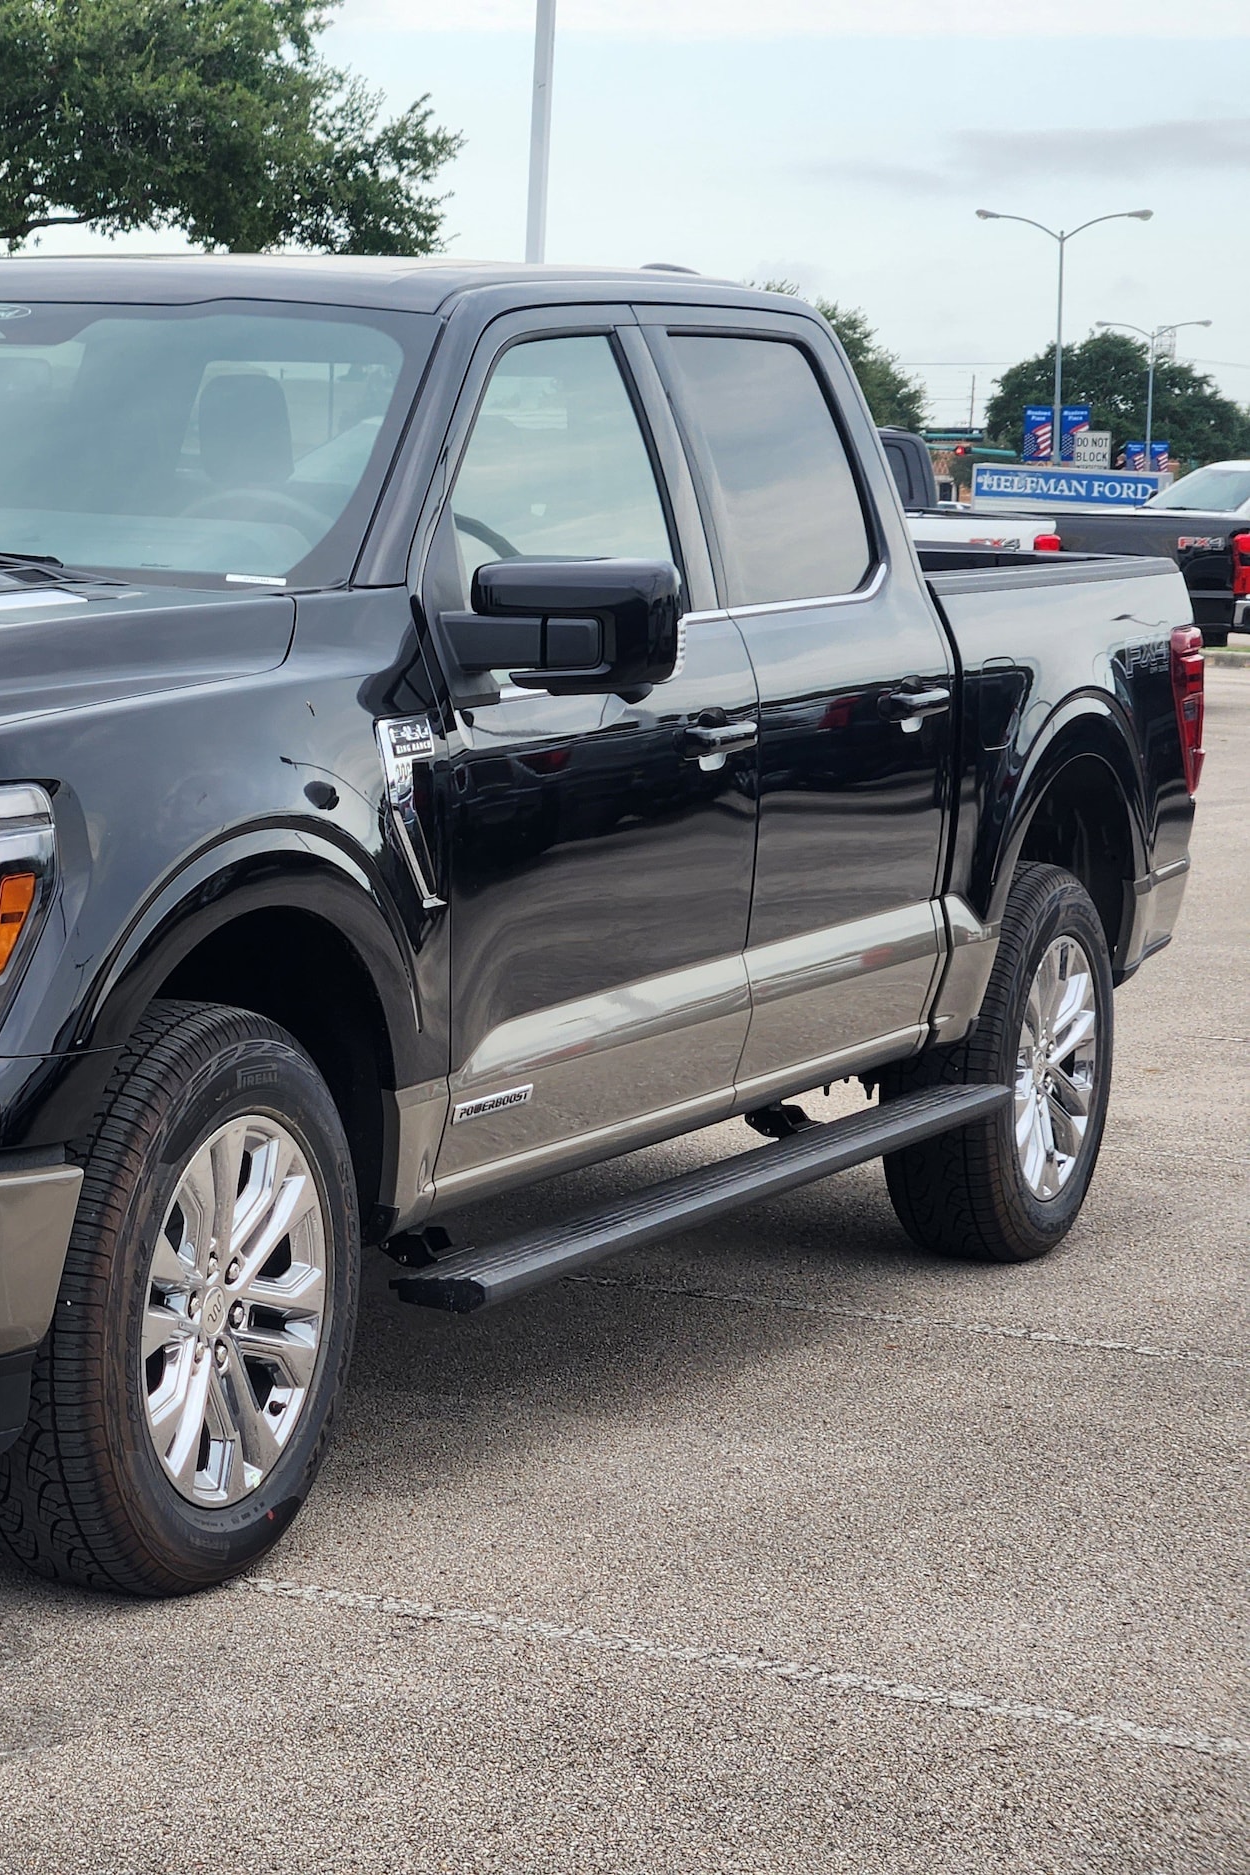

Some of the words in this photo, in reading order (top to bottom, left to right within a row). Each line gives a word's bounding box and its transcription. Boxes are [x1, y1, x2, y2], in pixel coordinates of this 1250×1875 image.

[1077, 437, 1089, 448] DO
[1091, 437, 1109, 448] NOT
[1076, 451, 1108, 462] BLOCK
[979, 473, 1087, 497] HELFMAN
[1091, 481, 1153, 500] FORD
[1177, 536, 1225, 551] FX4
[1125, 634, 1170, 680] FX4
[236, 1062, 278, 1089] PIRELLI
[459, 1089, 530, 1119] POWERBOOST
